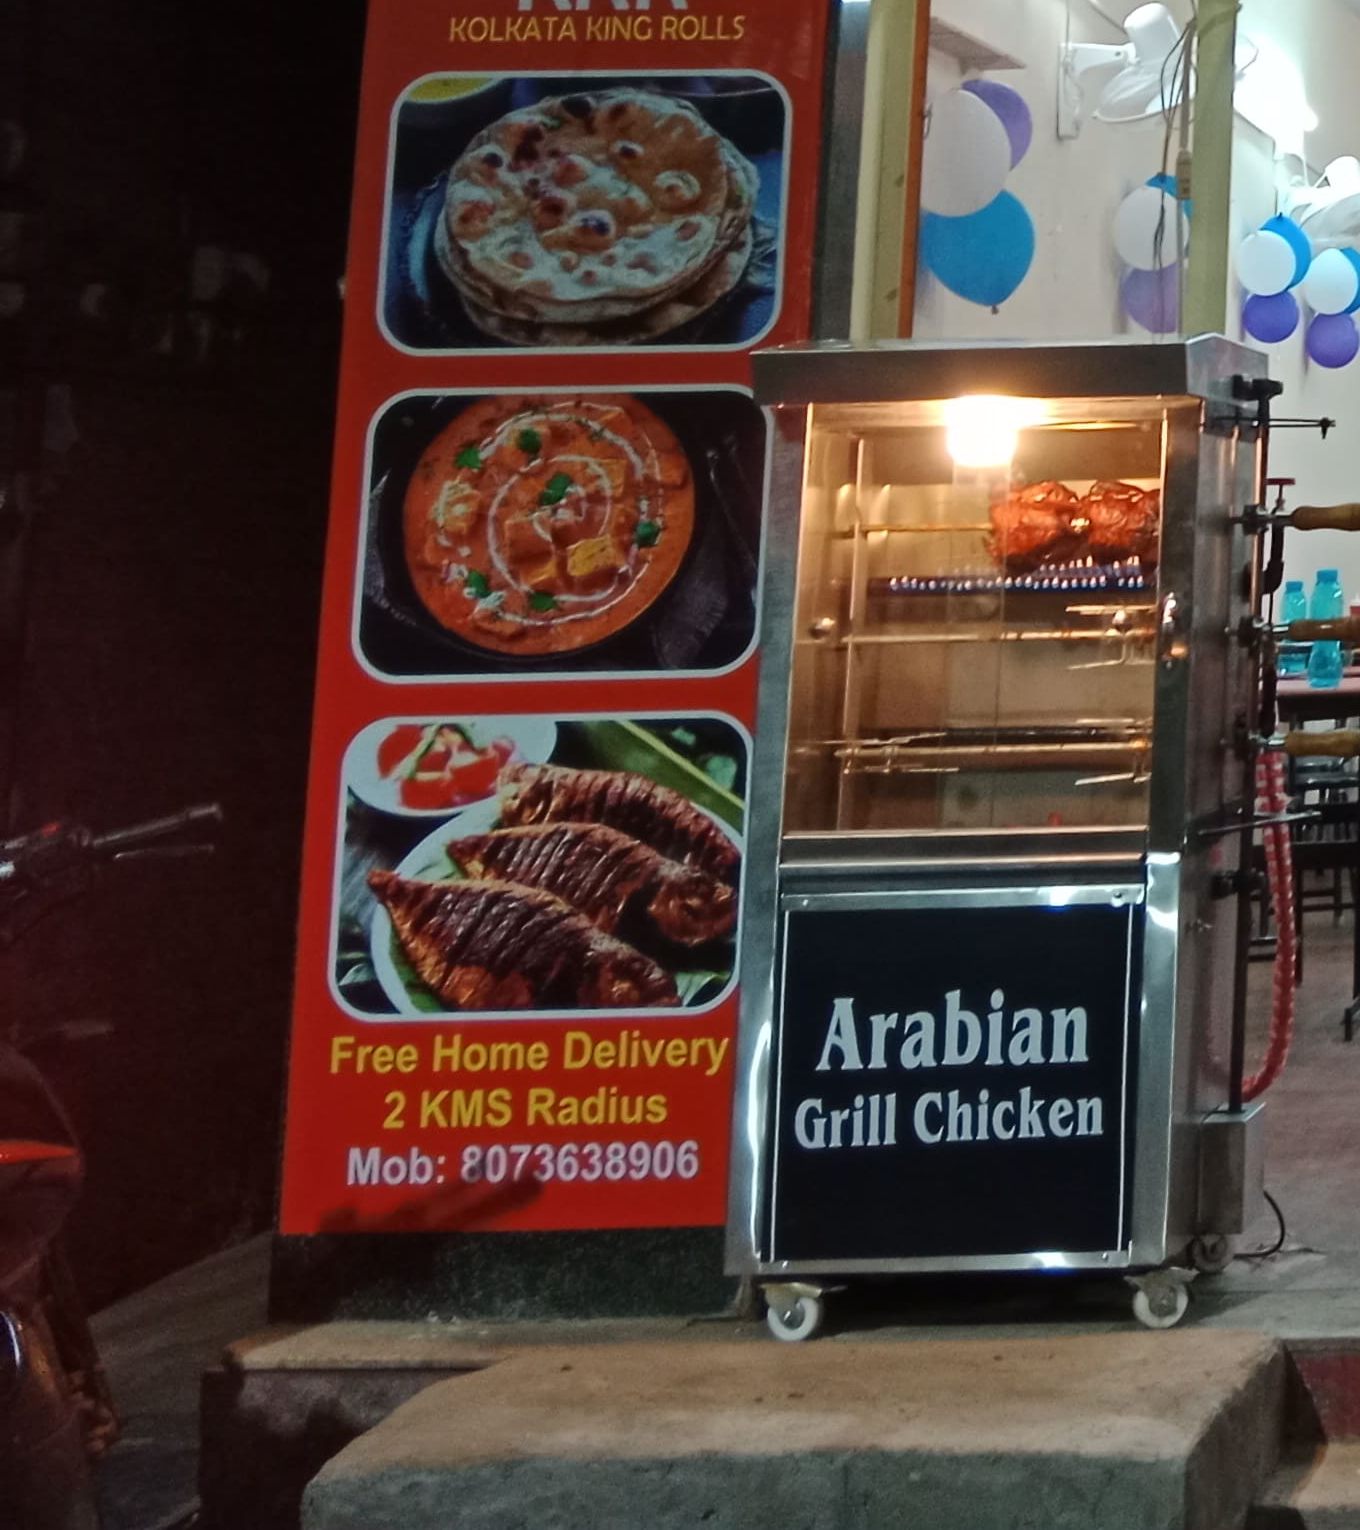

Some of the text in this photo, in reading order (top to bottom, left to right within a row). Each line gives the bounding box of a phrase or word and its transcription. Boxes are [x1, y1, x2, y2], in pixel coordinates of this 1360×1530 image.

[449, 15, 745, 41] KOLKATA KING ROLLS
[330, 1028, 728, 1078] Free Home Delivery
[816, 990, 1090, 1073] Arabian
[384, 1086, 667, 1129] 2 KMS Radius
[795, 1087, 1105, 1149] Grill Chicken
[346, 1140, 699, 1186] Mob: 8073638906
